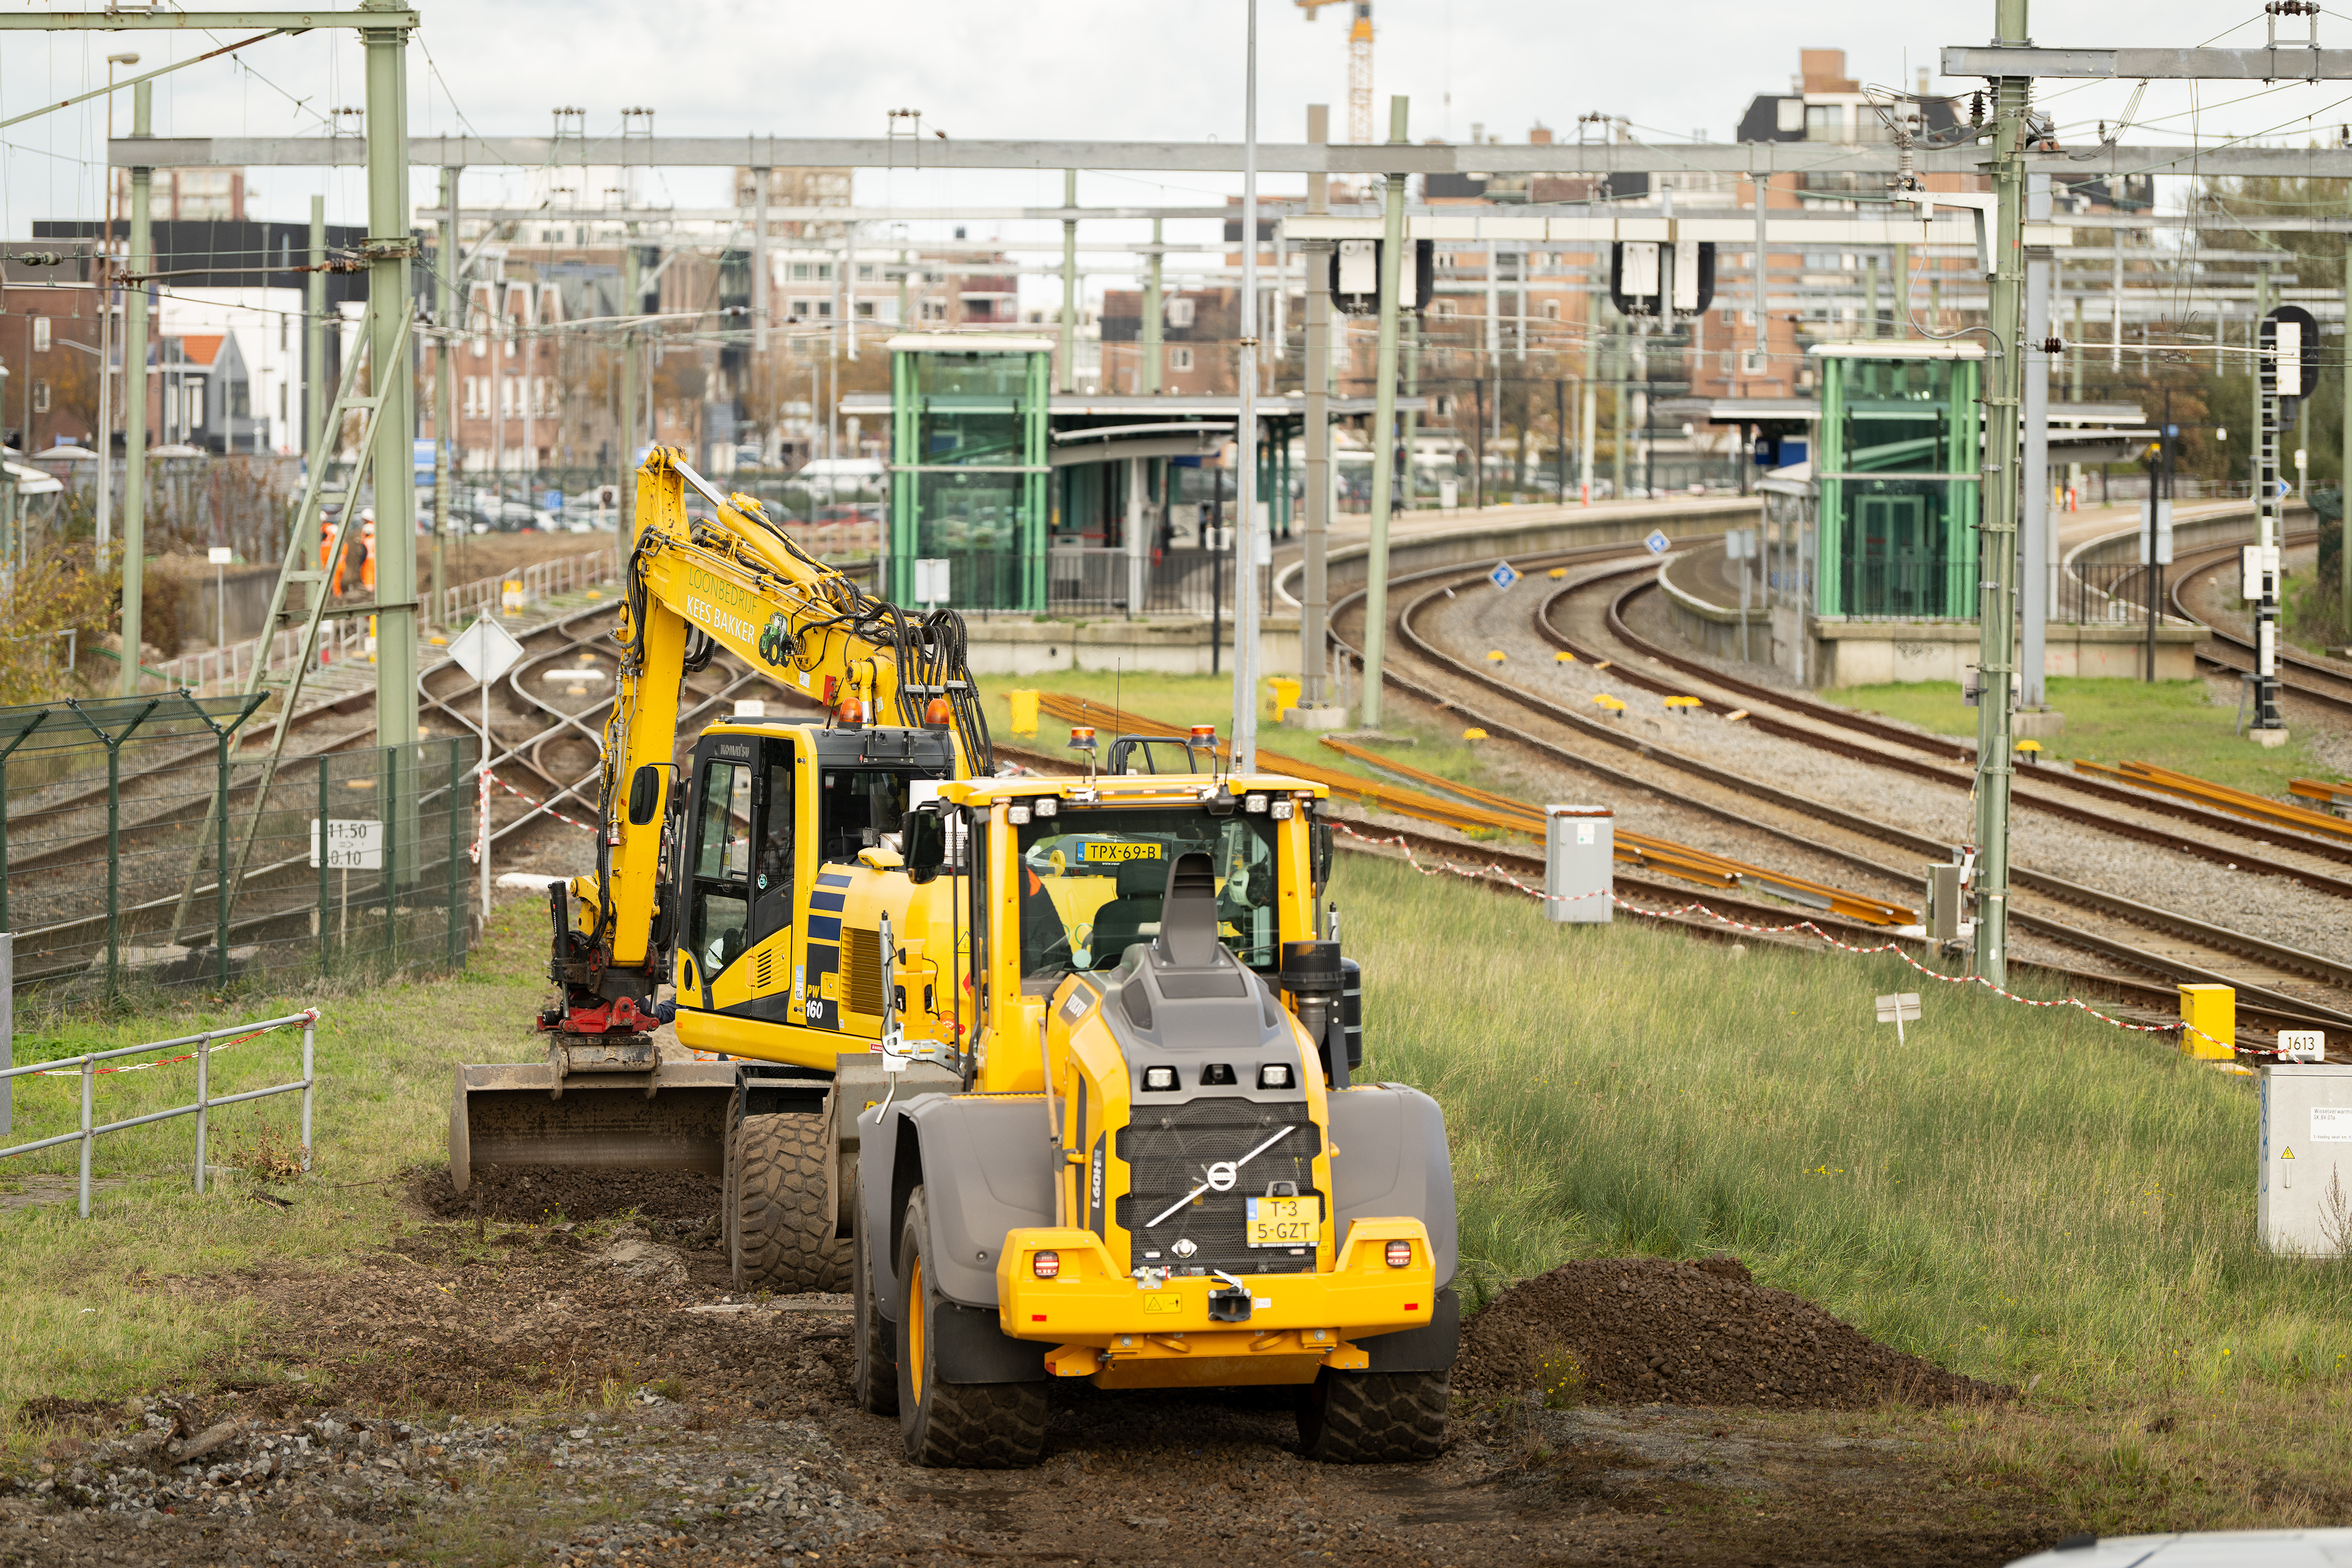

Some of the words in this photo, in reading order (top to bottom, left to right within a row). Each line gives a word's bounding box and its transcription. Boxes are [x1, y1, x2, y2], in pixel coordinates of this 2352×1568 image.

[689, 566, 758, 615] LOONBEDRIJF
[686, 594, 712, 624] KEES
[713, 607, 755, 646] BAKKER
[720, 744, 750, 758] KOMATSU
[329, 823, 366, 838] 11.50
[331, 850, 361, 865] 0.10
[1091, 845, 1155, 859] TPX-69-B
[807, 984, 820, 999] PW
[806, 1000, 823, 1019] 160
[2288, 1037, 2314, 1050] 1613
[1092, 1161, 1102, 1208] L60H
[1271, 1200, 1297, 1216] T-3
[1257, 1222, 1310, 1239] 5-GZT
